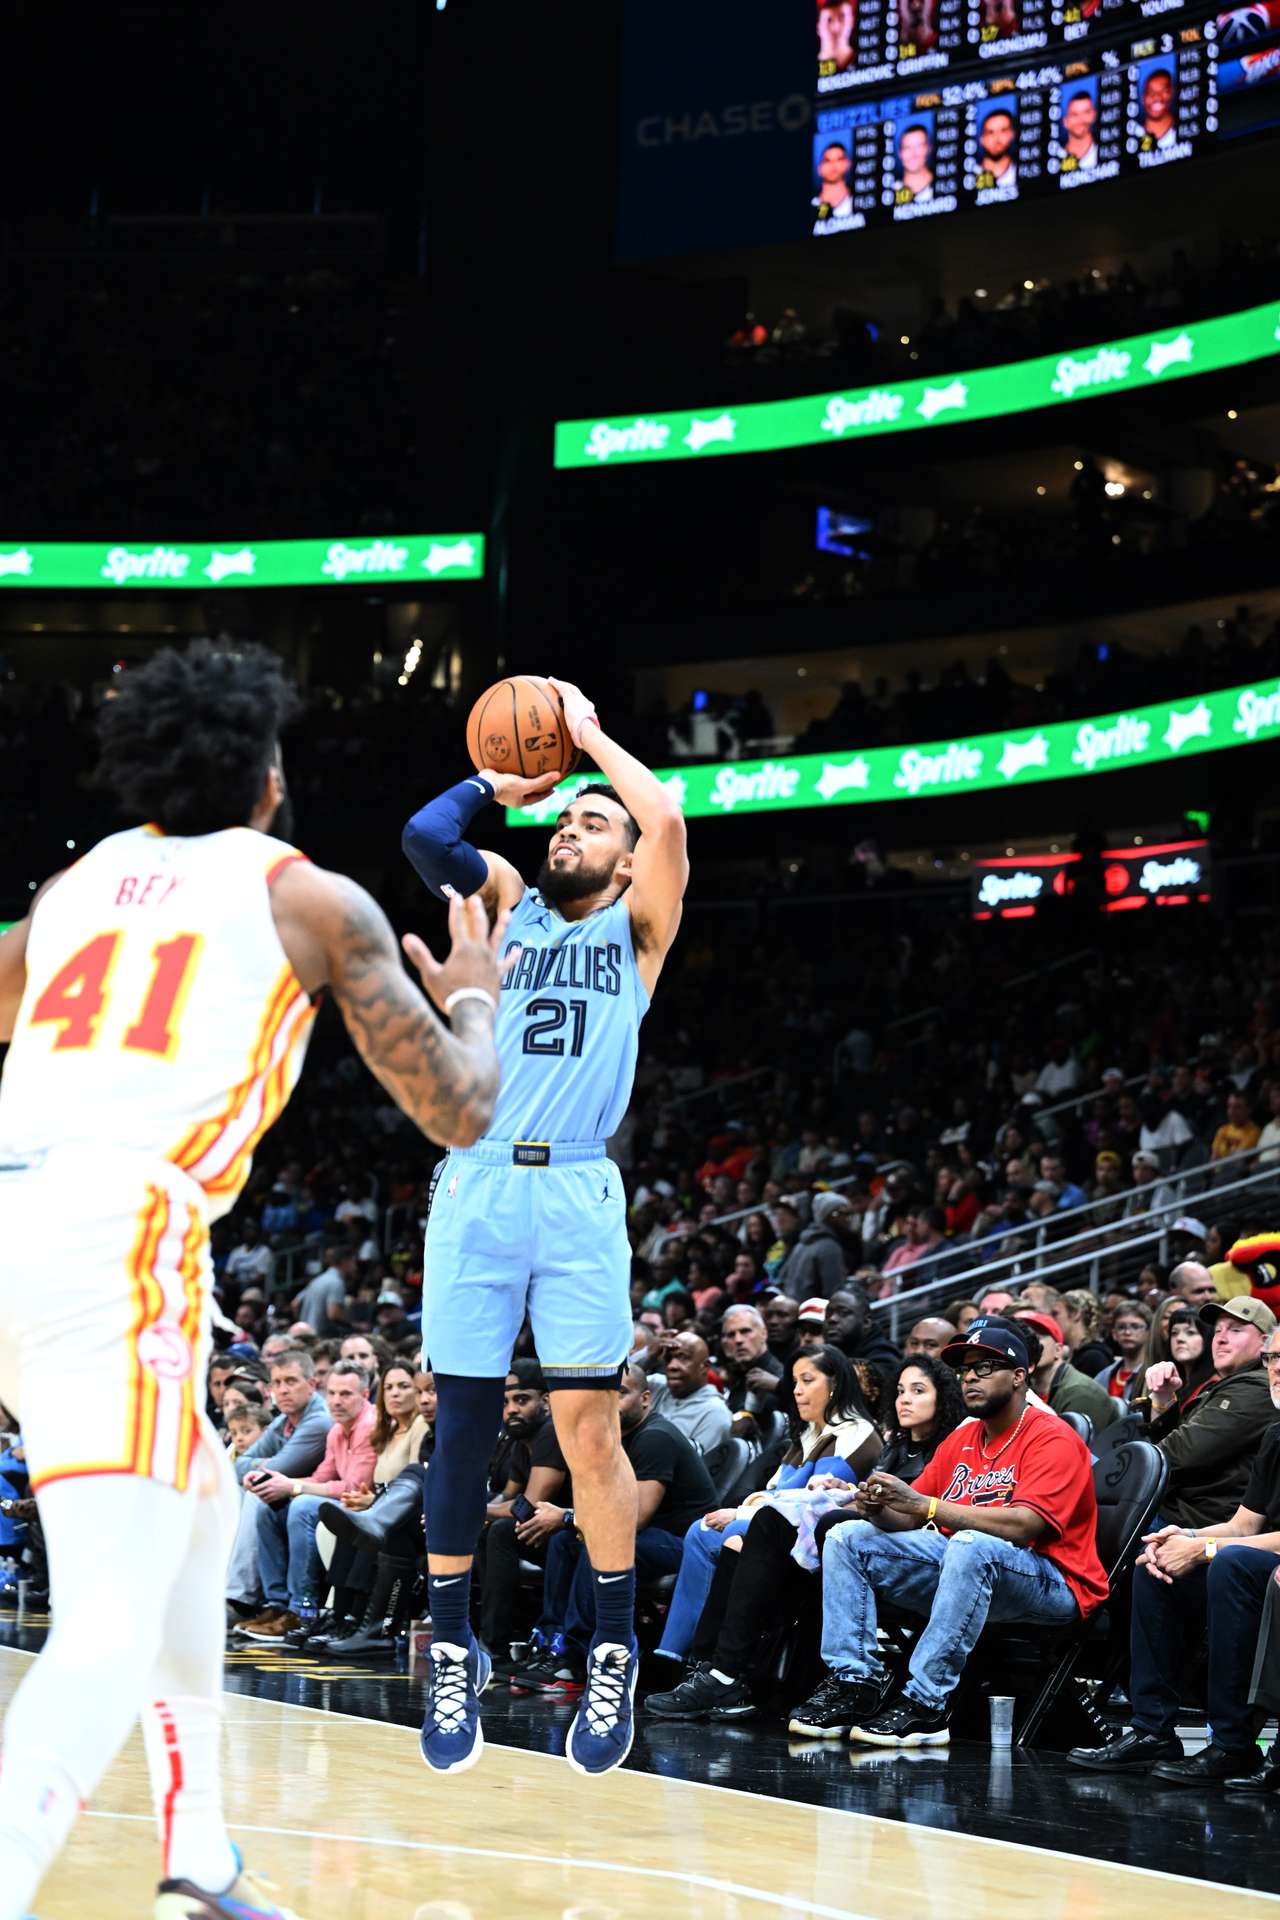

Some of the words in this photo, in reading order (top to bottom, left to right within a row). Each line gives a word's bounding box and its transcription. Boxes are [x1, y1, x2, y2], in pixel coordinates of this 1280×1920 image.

[1161, 33, 1174, 53] 3
[1203, 19, 1218, 40] 6
[1206, 42, 1219, 59] 0
[1127, 64, 1139, 82] 0
[1206, 60, 1218, 76] 4
[1050, 87, 1062, 104] 2
[965, 104, 977, 121] 2
[1048, 104, 1062, 121] 0
[1126, 101, 1139, 118] 0
[1206, 97, 1219, 114] 0
[636, 101, 775, 147] CHASE
[883, 120, 897, 137] 0
[965, 122, 977, 137] 4
[1126, 119, 1138, 136] 0
[1205, 115, 1218, 132] 0
[963, 139, 977, 156] 0
[1047, 140, 1060, 157] 0
[1125, 136, 1138, 154] 0
[882, 155, 896, 171] 0
[963, 156, 976, 173] 0
[1047, 157, 1060, 174] 0
[881, 172, 895, 189] 0
[963, 173, 976, 190] 0
[881, 189, 895, 206] 0
[1051, 347, 1132, 398] Sprite
[821, 389, 904, 436] Sprite
[584, 417, 671, 461] Sprite
[101, 546, 191, 585] Sprite
[322, 539, 409, 581] Sprite
[1072, 715, 1150, 771] Sprite
[893, 743, 984, 795] Sprite
[709, 761, 800, 811] Sprite
[1139, 857, 1200, 894] Sprite
[115, 874, 186, 906] BEY
[978, 871, 1043, 906] Sprite
[28, 927, 206, 1064] 41
[522, 998, 588, 1058] 21
[942, 1462, 1017, 1502] Braves
